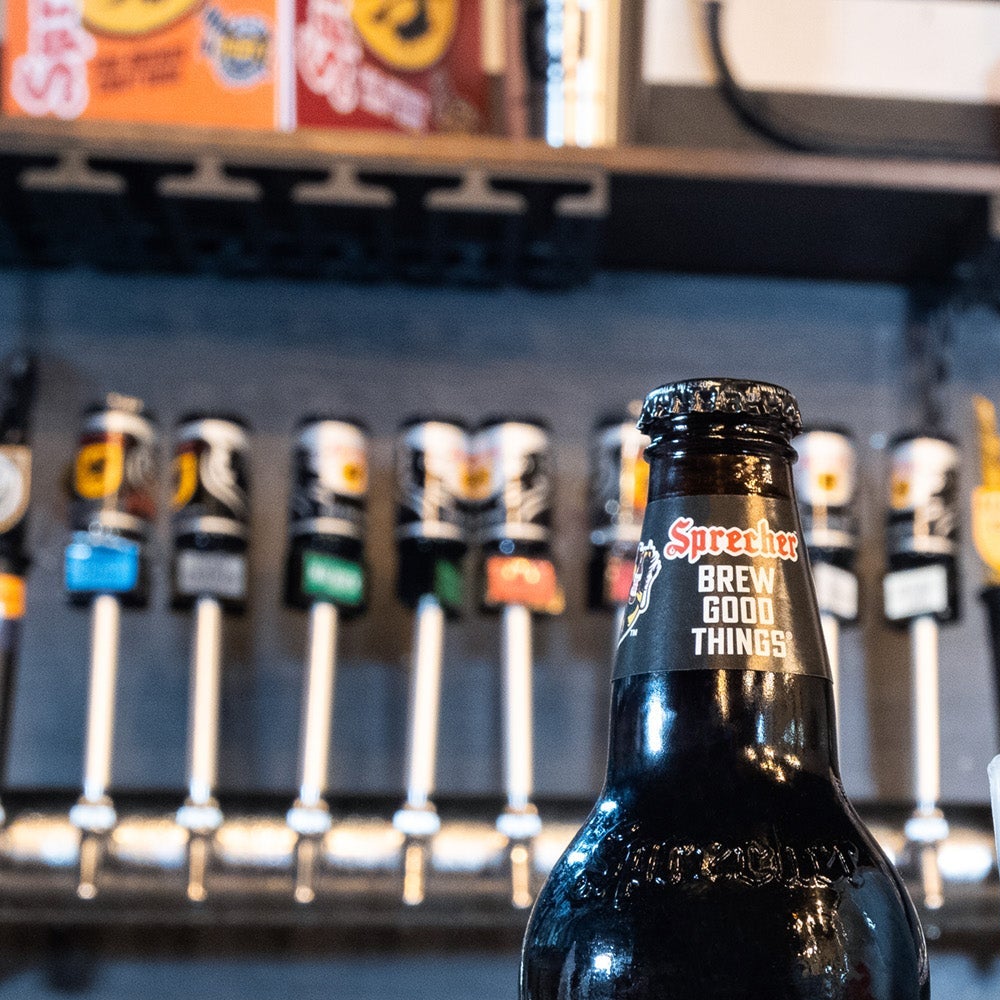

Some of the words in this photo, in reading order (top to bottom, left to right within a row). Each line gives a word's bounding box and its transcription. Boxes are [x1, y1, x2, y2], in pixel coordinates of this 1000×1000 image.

[664, 517, 798, 564] Sprecher
[698, 565, 775, 594] BREW
[703, 596, 775, 625] GOOD
